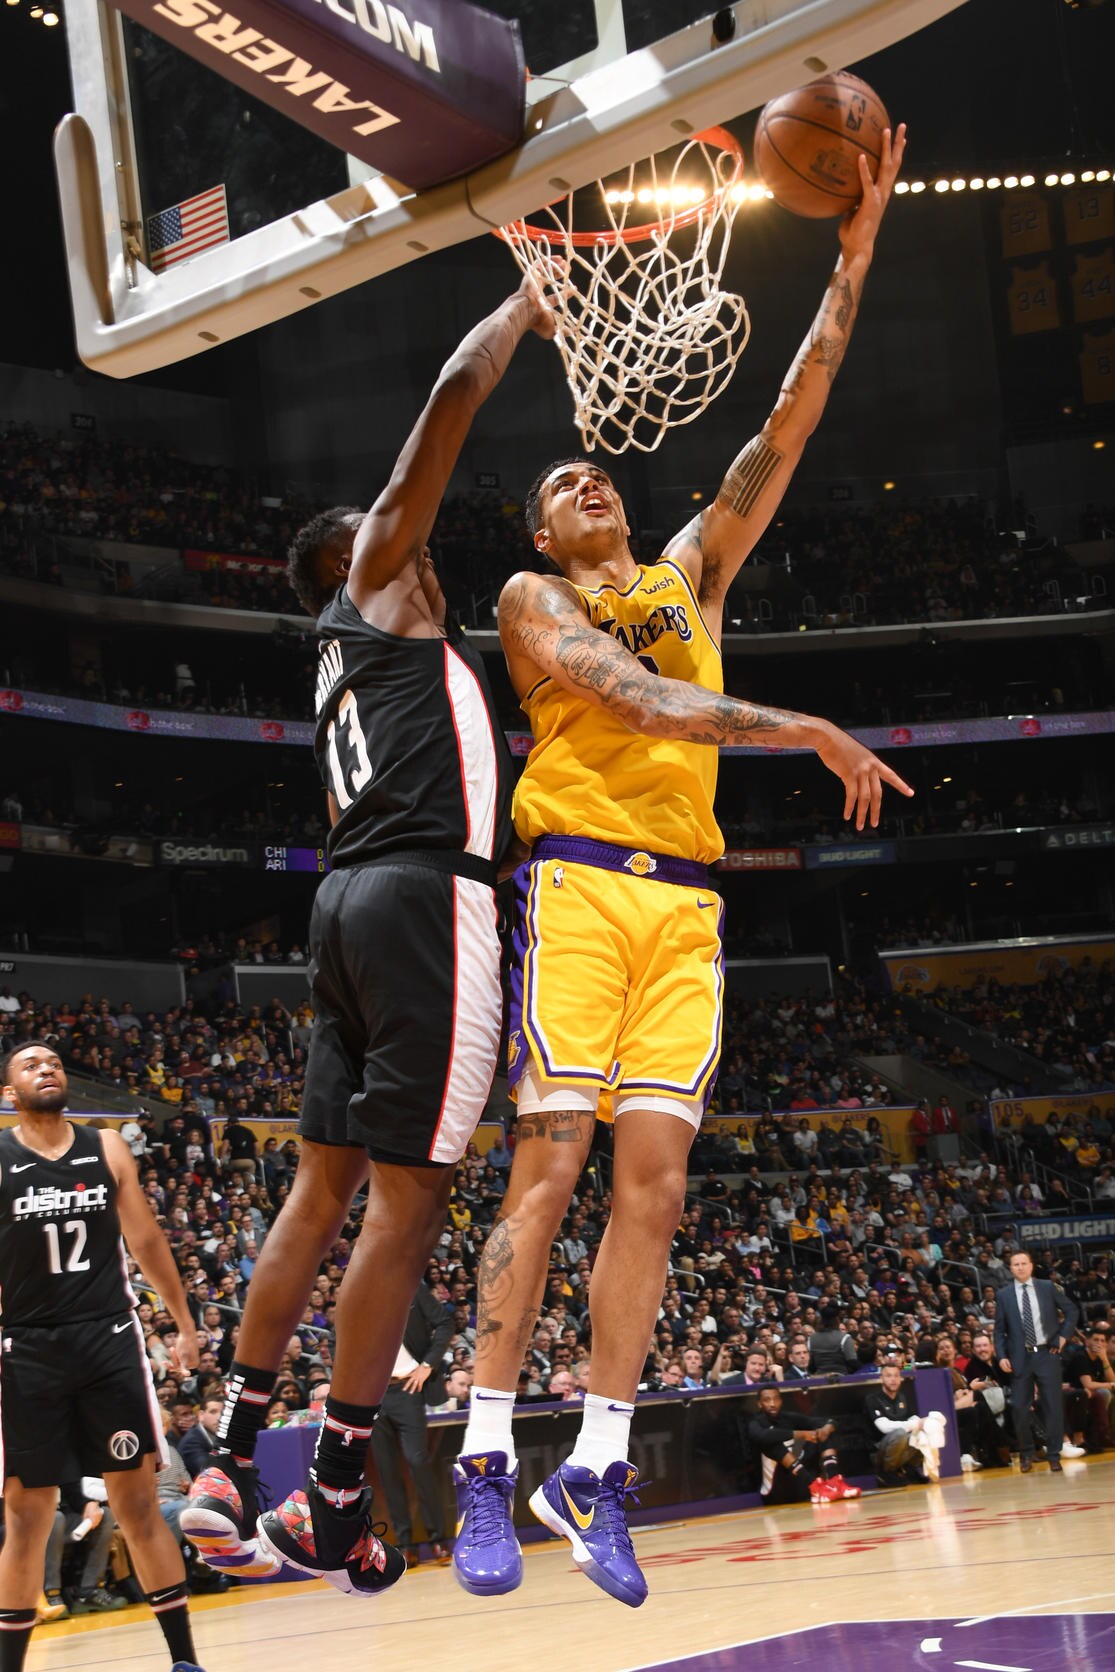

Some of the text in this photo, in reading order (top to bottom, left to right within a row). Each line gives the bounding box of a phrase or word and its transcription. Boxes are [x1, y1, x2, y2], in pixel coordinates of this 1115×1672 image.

[1082, 274, 1113, 299] 44
[1016, 287, 1048, 312] 34
[640, 577, 675, 594] wish
[327, 689, 373, 809] 13
[1064, 830, 1115, 846] DELT
[161, 842, 248, 864] Spectrum
[265, 846, 287, 858] CHI
[721, 851, 800, 867] TOSHIBA
[819, 849, 881, 863] BUD LIGHT
[265, 859, 287, 871] ARI
[995, 1102, 1025, 1119] 105
[13, 1182, 108, 1215] district
[37, 1186, 56, 1195] THE
[1020, 1223, 1062, 1241] BUD
[42, 1219, 91, 1275] 12
